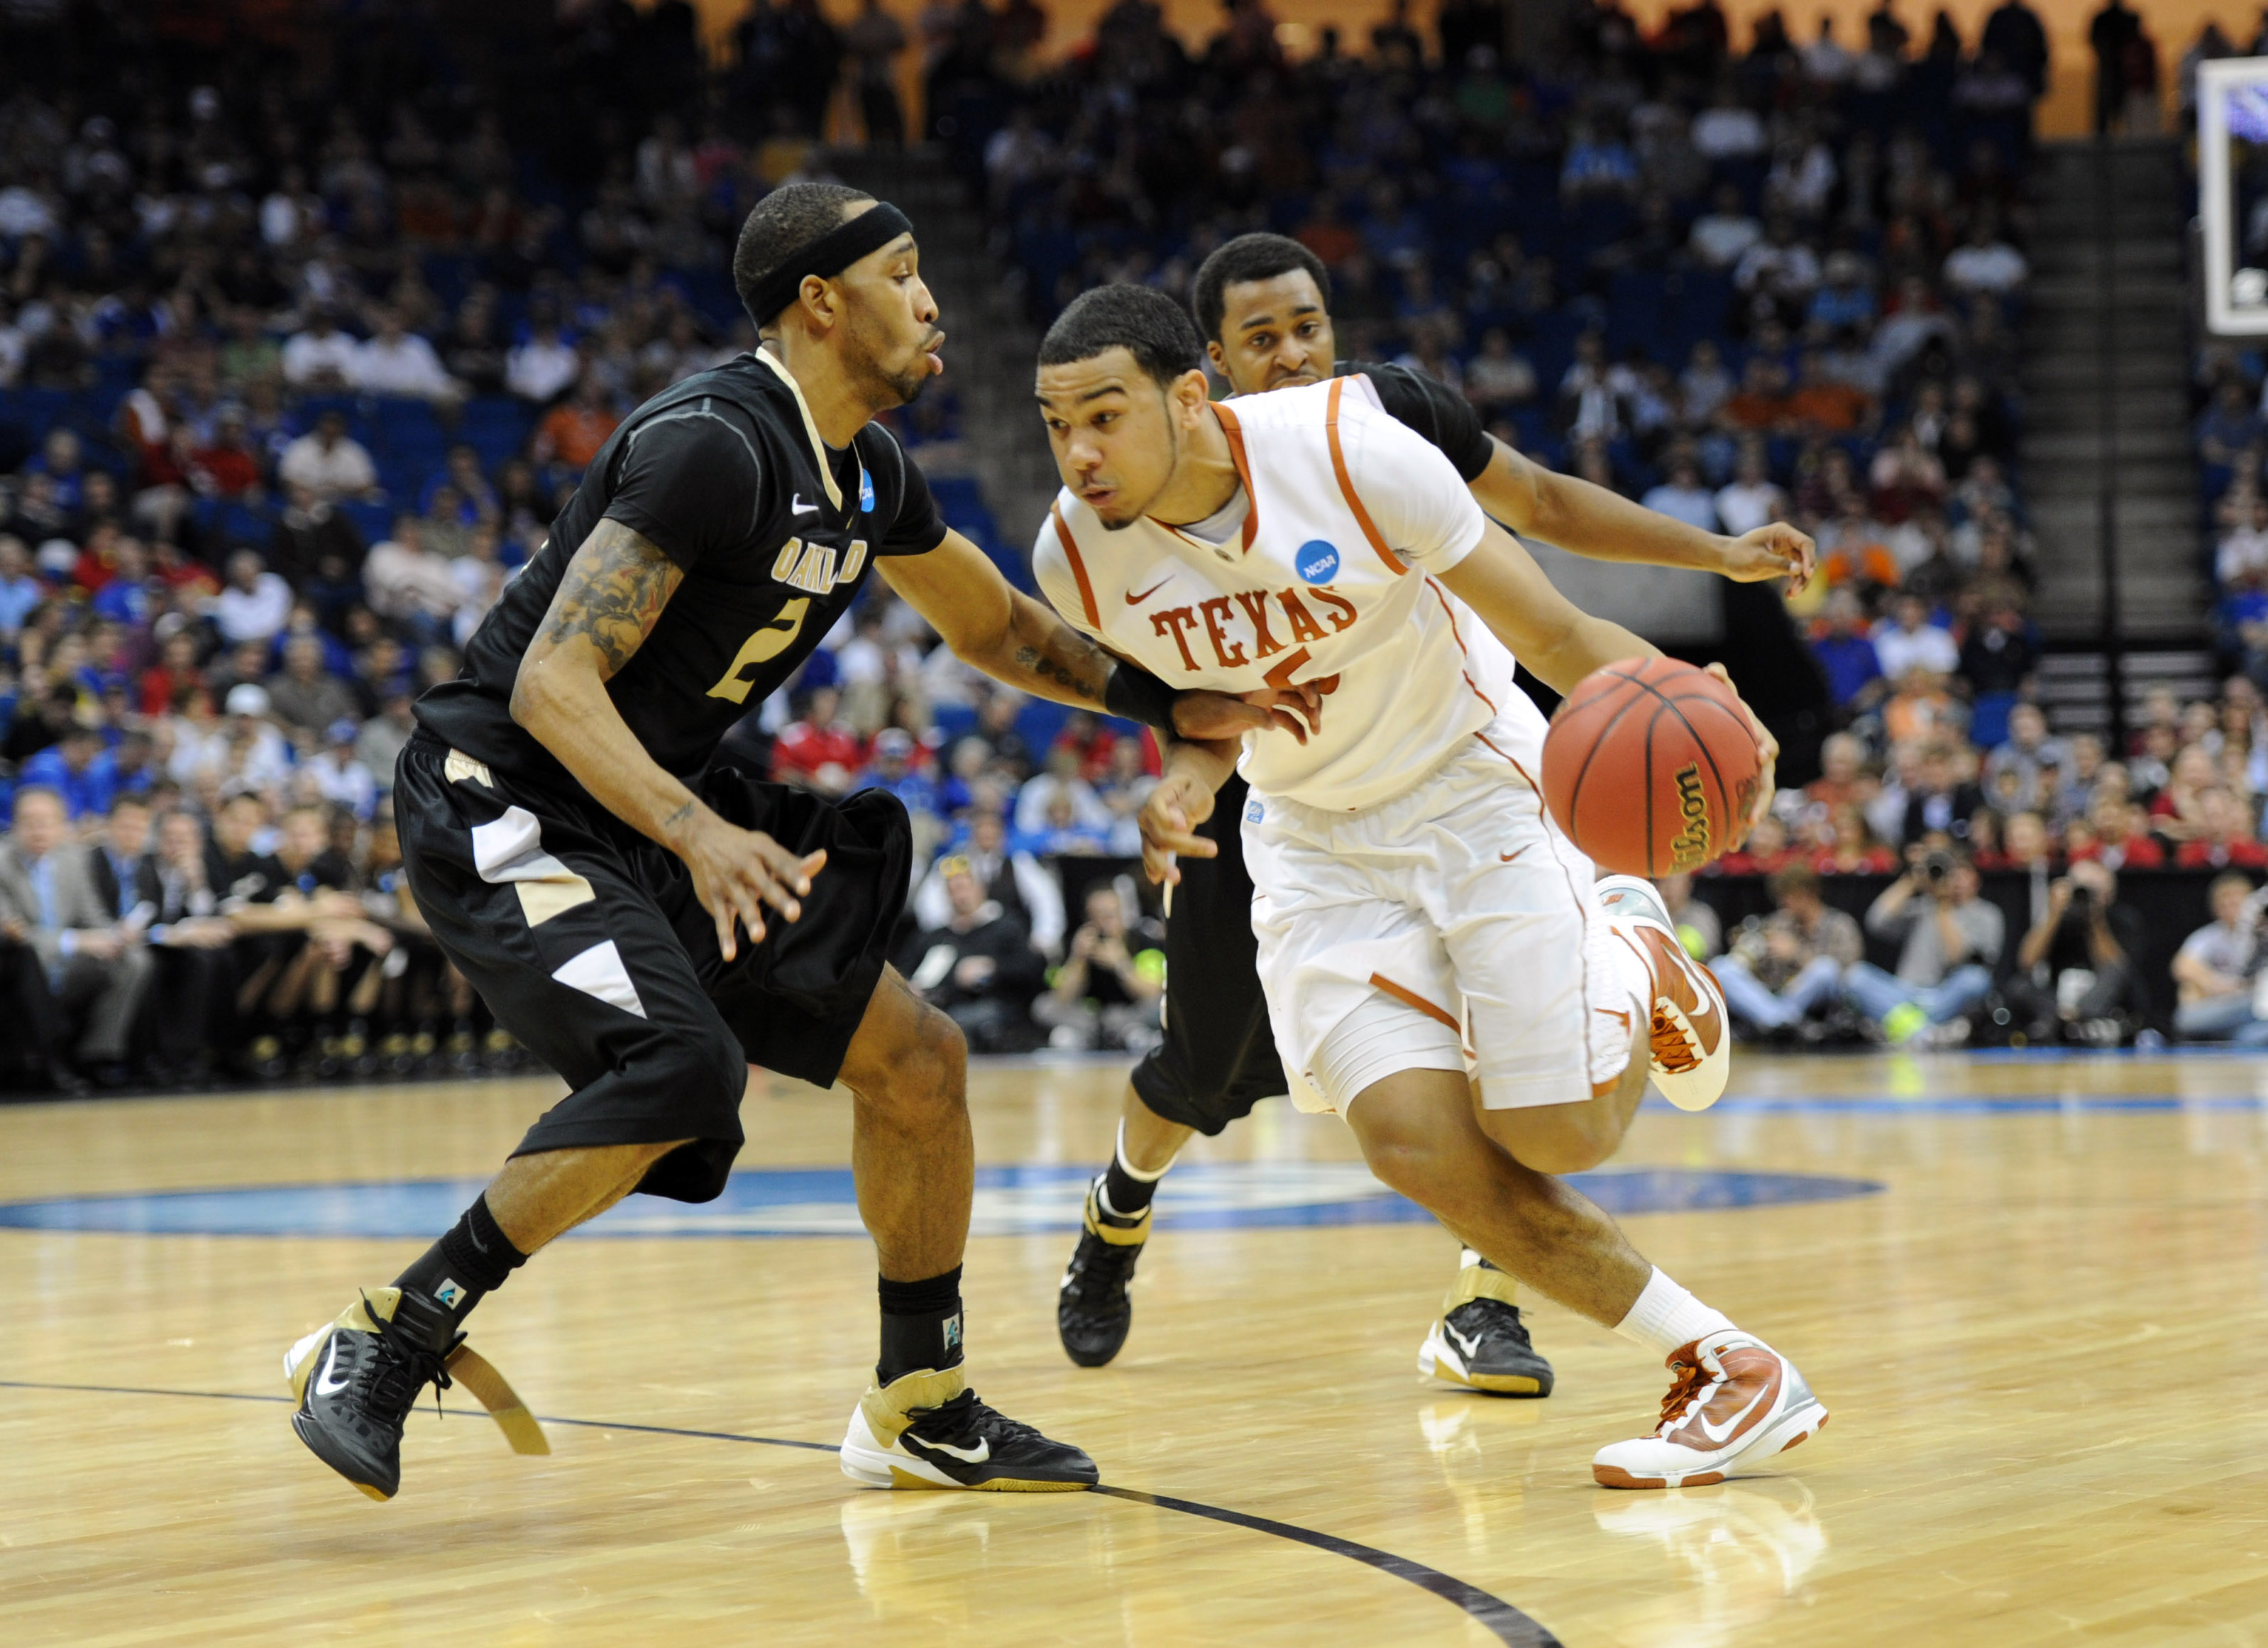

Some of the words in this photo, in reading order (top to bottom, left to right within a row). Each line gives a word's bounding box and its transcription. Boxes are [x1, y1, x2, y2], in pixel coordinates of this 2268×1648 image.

[771, 536, 867, 594] OAKLD
[1303, 554, 1336, 578] NCAA
[705, 597, 810, 704] 2
[1149, 586, 1357, 671] TEXAS
